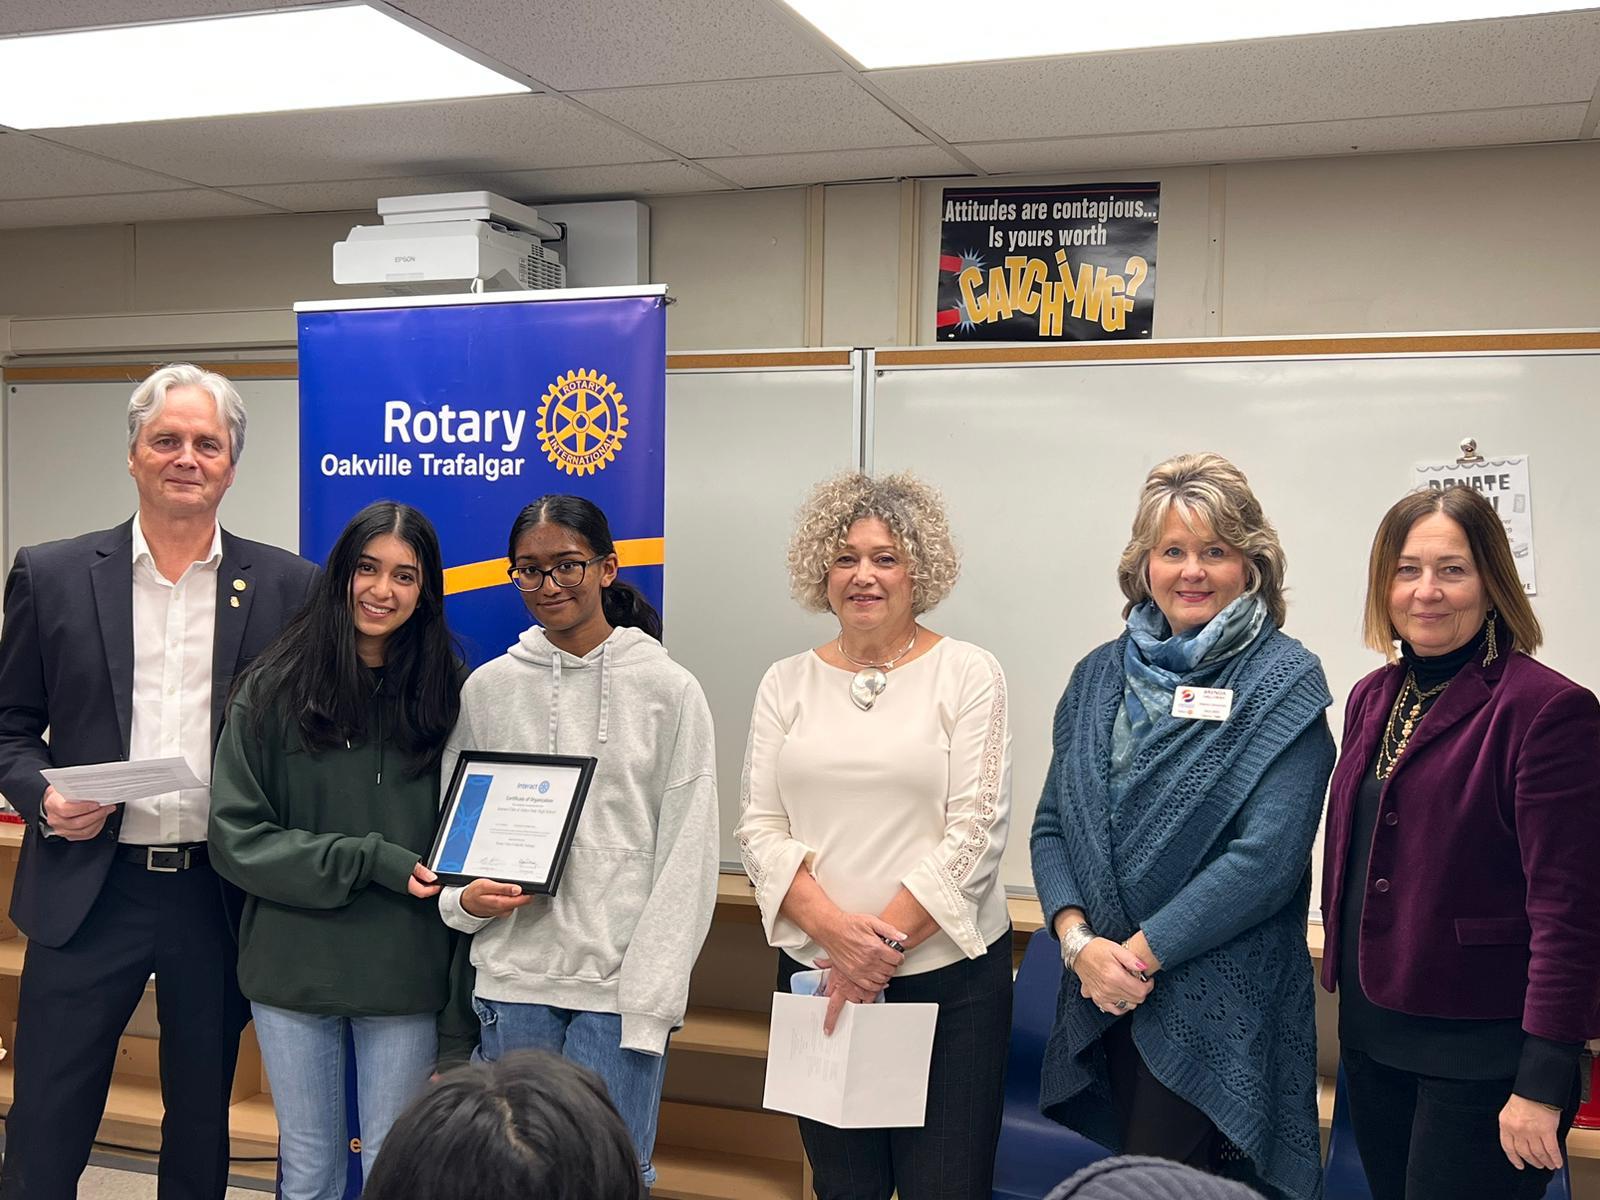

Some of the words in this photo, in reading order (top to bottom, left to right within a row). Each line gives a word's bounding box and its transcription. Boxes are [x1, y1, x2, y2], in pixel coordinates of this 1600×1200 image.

[945, 199, 1016, 222] Attitudes
[1021, 201, 1048, 220] are
[1052, 196, 1157, 223] contagious...
[989, 226, 1004, 248] Is
[1008, 229, 1053, 252] yours
[1058, 224, 1107, 247] worth
[562, 380, 601, 394] ROTARY
[384, 400, 526, 452] Rotary
[549, 438, 615, 466] INTERNATIONAL
[320, 453, 412, 476] Oakville
[419, 453, 525, 482] Trafalgar
